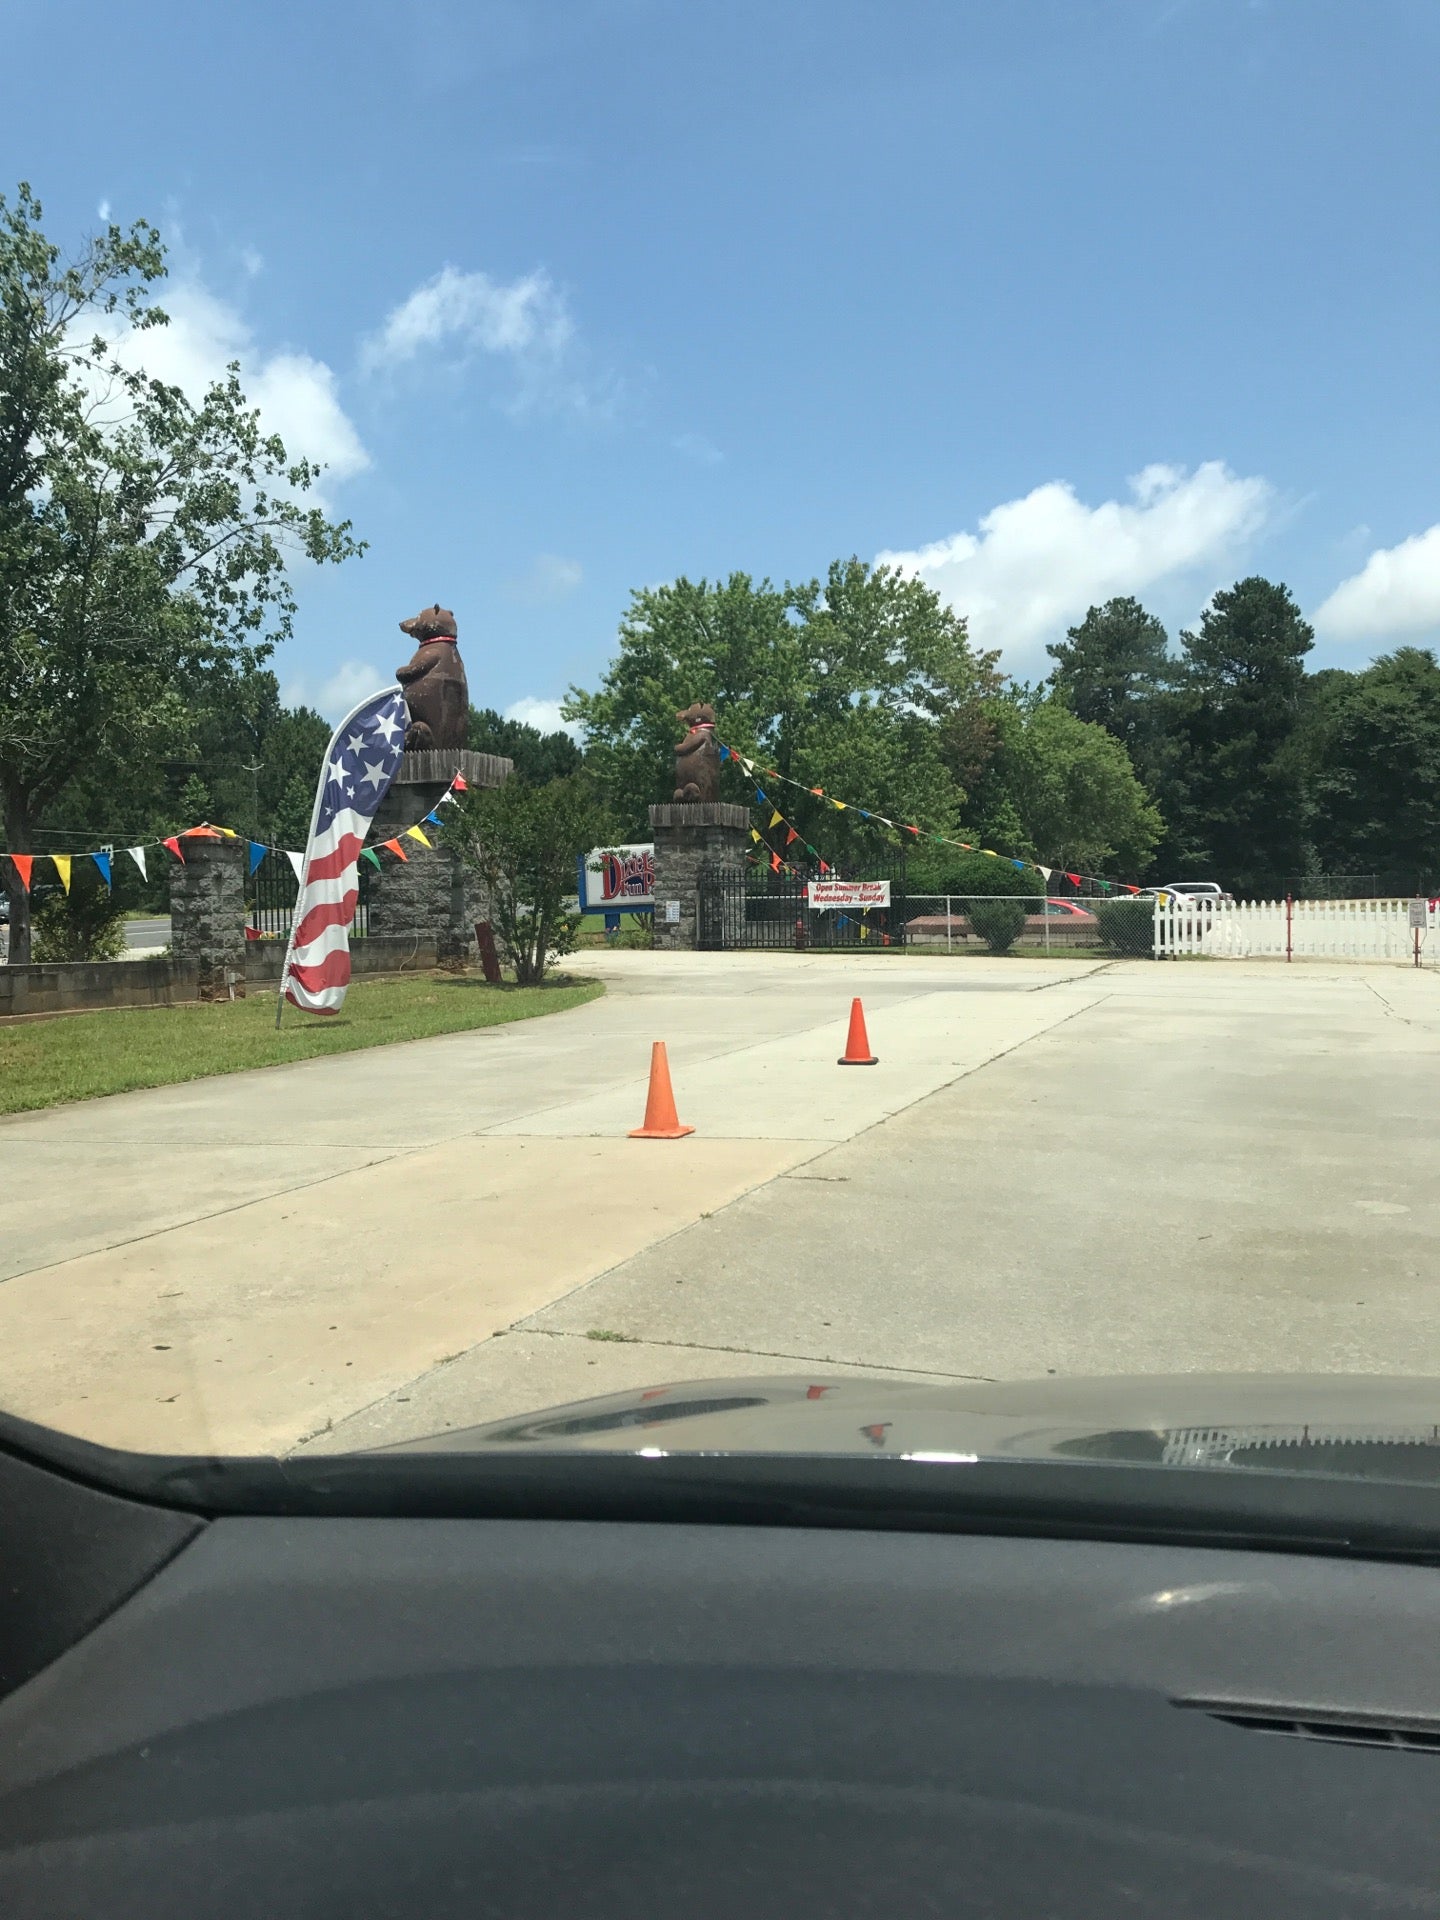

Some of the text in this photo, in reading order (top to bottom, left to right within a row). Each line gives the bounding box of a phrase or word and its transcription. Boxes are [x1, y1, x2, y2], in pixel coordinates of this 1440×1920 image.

[816, 882, 881, 892] Open Summer Break
[813, 893, 853, 903] Wednesday
[859, 893, 885, 902] Sunday
